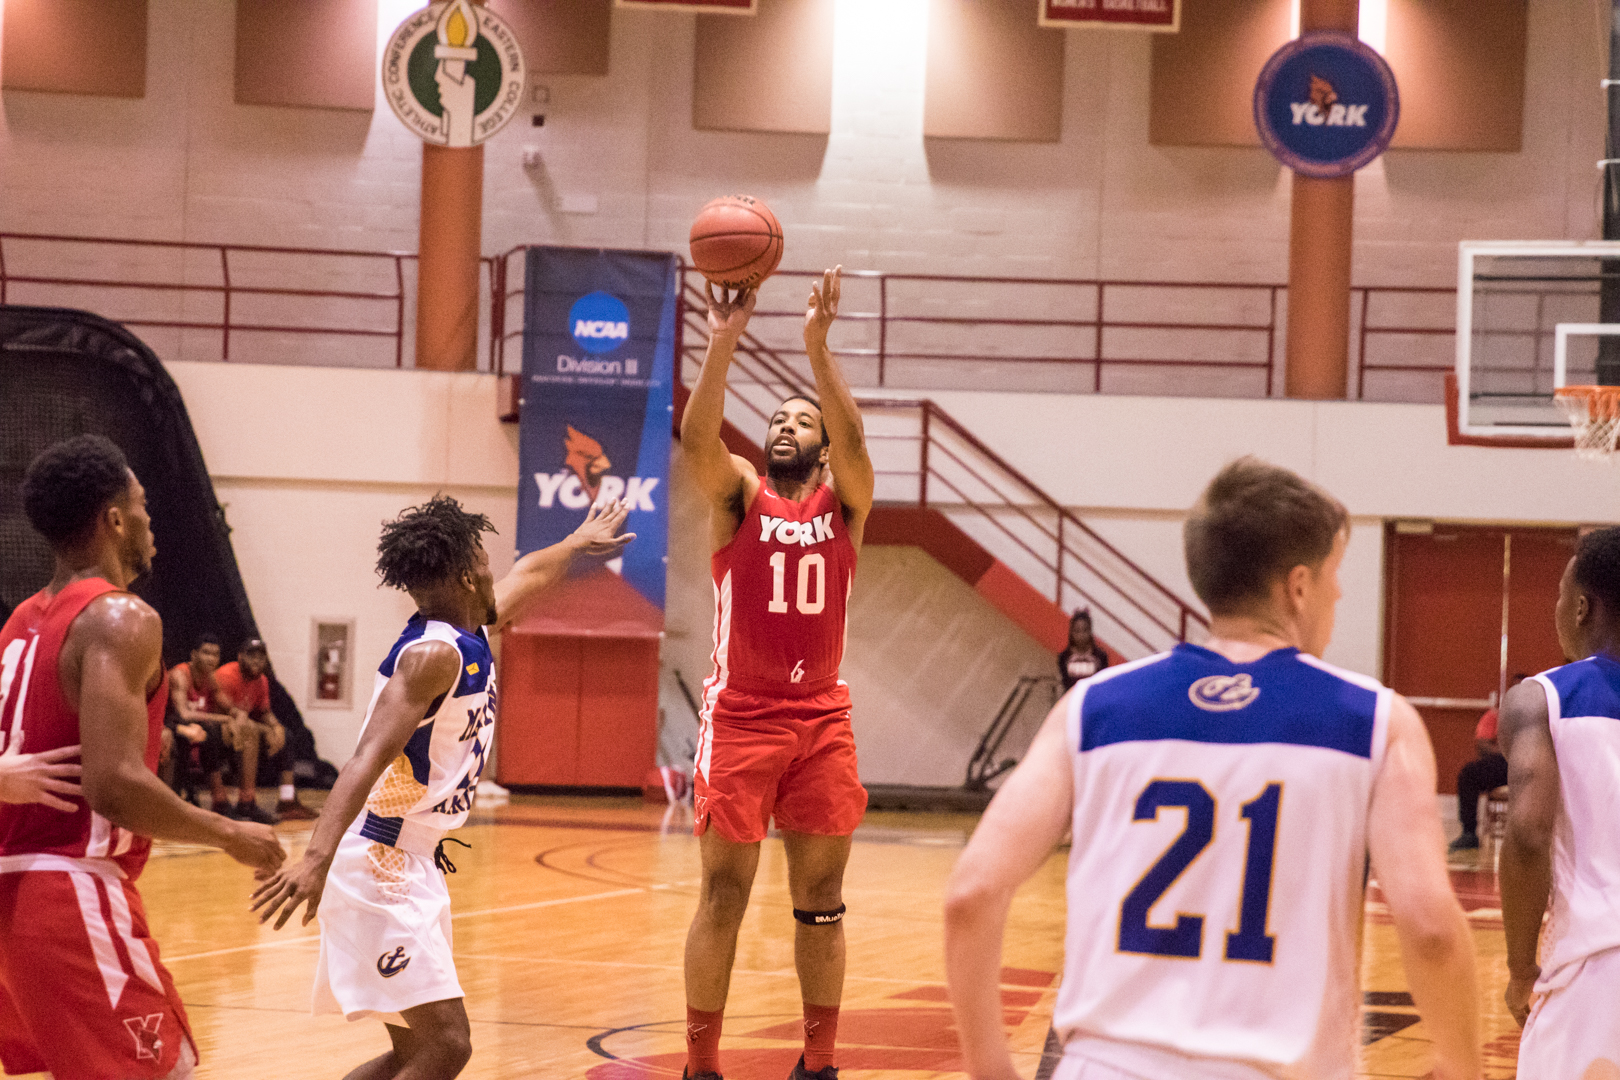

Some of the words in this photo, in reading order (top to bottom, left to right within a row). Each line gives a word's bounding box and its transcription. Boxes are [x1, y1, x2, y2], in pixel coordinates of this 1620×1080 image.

[483, 16, 519, 72] EASTERN
[1290, 102, 1369, 127] YORK
[574, 319, 629, 339] NCAA
[556, 354, 622, 375] Division
[533, 468, 660, 512] YORK
[759, 511, 835, 547] YORK
[767, 551, 826, 615] 10
[1114, 776, 1286, 966] 21
